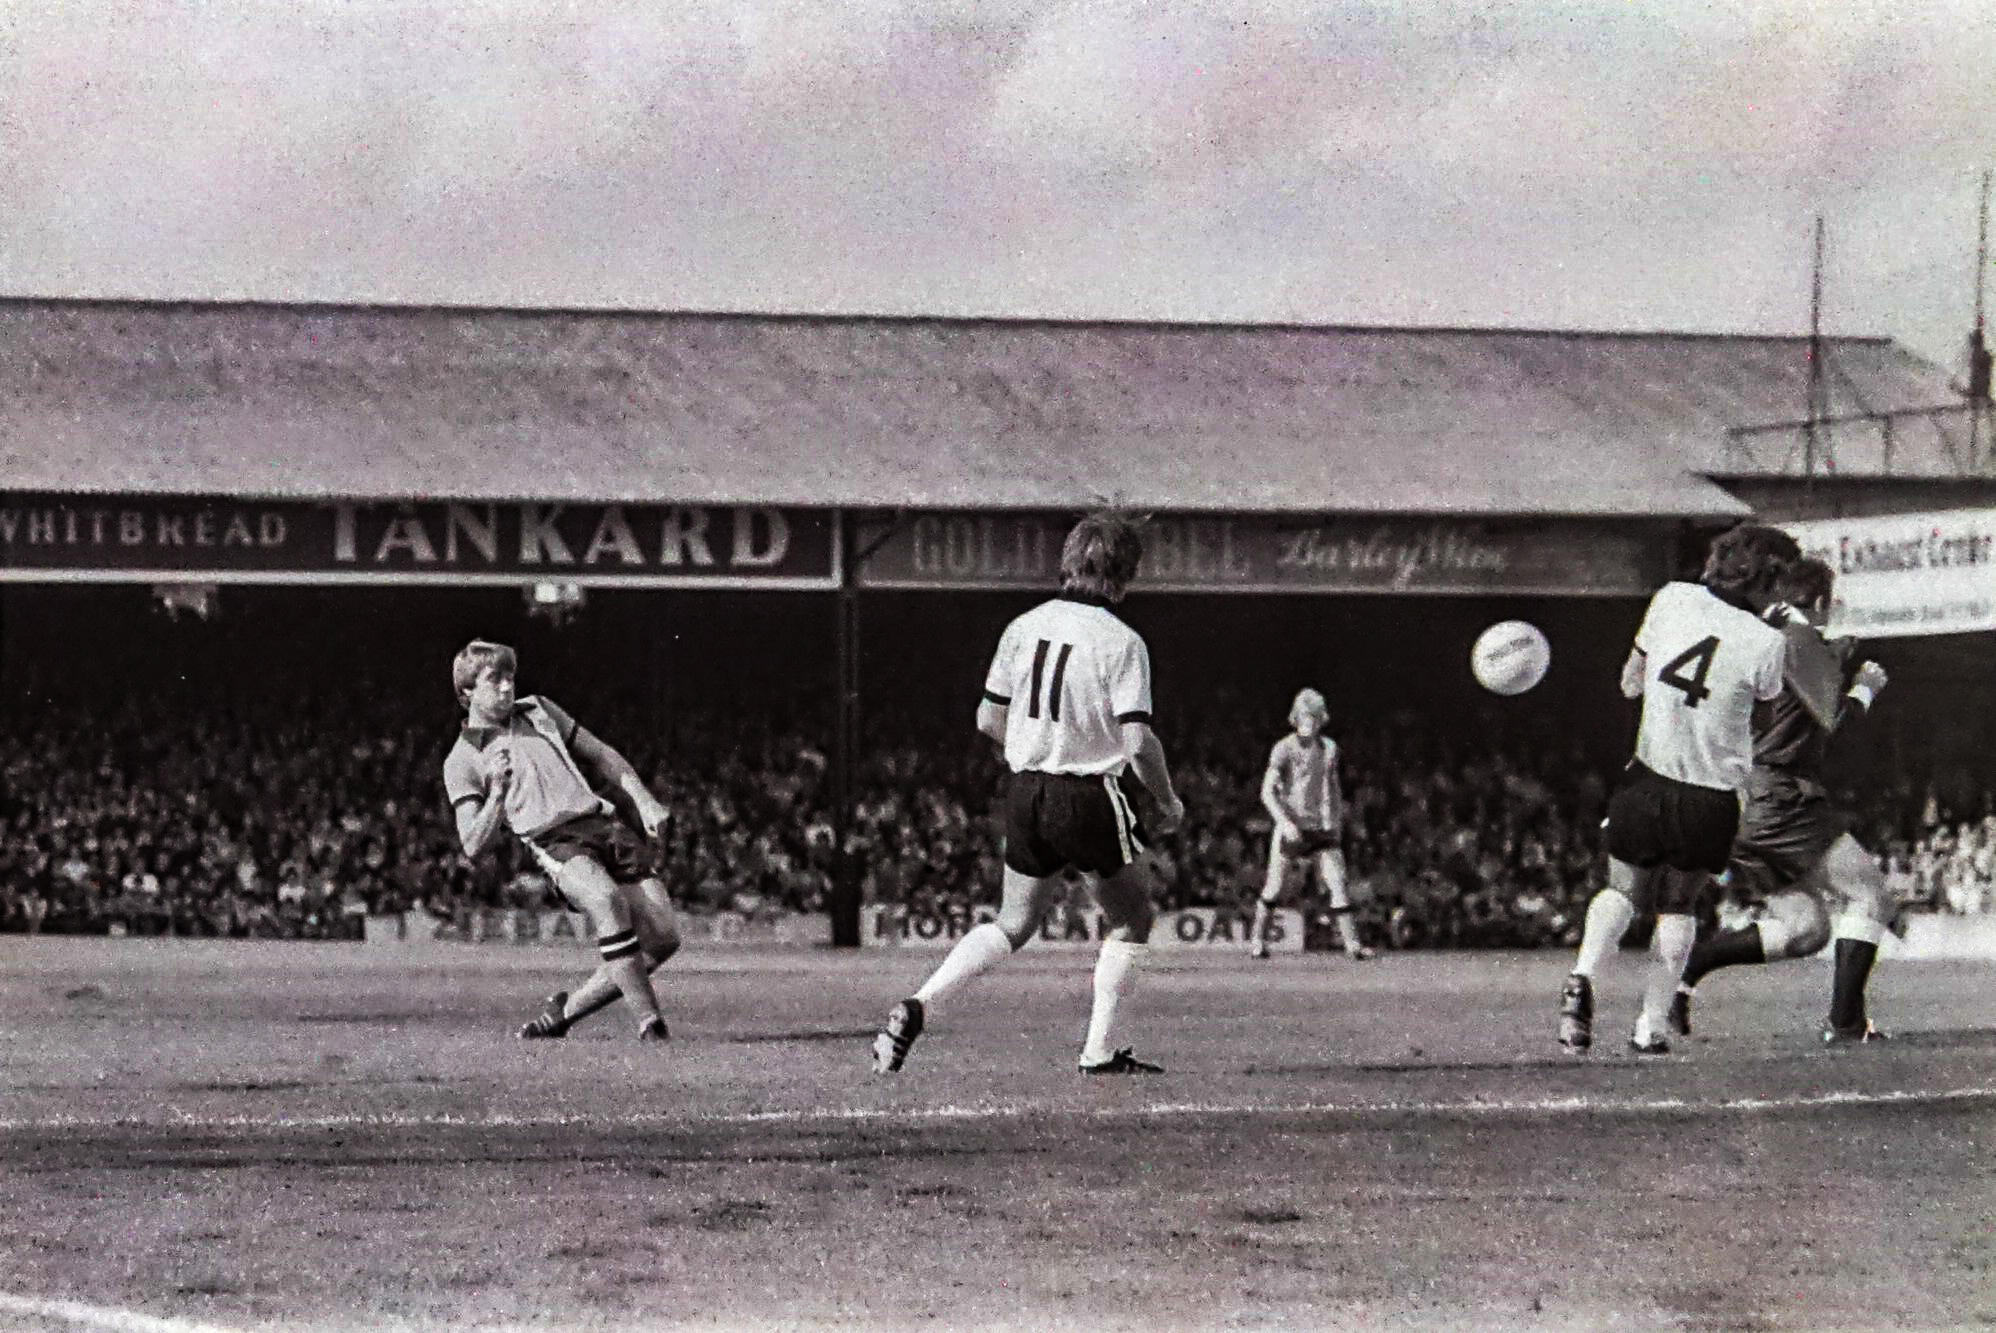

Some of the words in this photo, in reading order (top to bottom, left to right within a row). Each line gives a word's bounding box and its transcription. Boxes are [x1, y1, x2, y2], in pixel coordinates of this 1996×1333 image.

[324, 501, 792, 566] TANKARD
[1028, 638, 1074, 723] 11
[1657, 635, 1720, 709] 4
